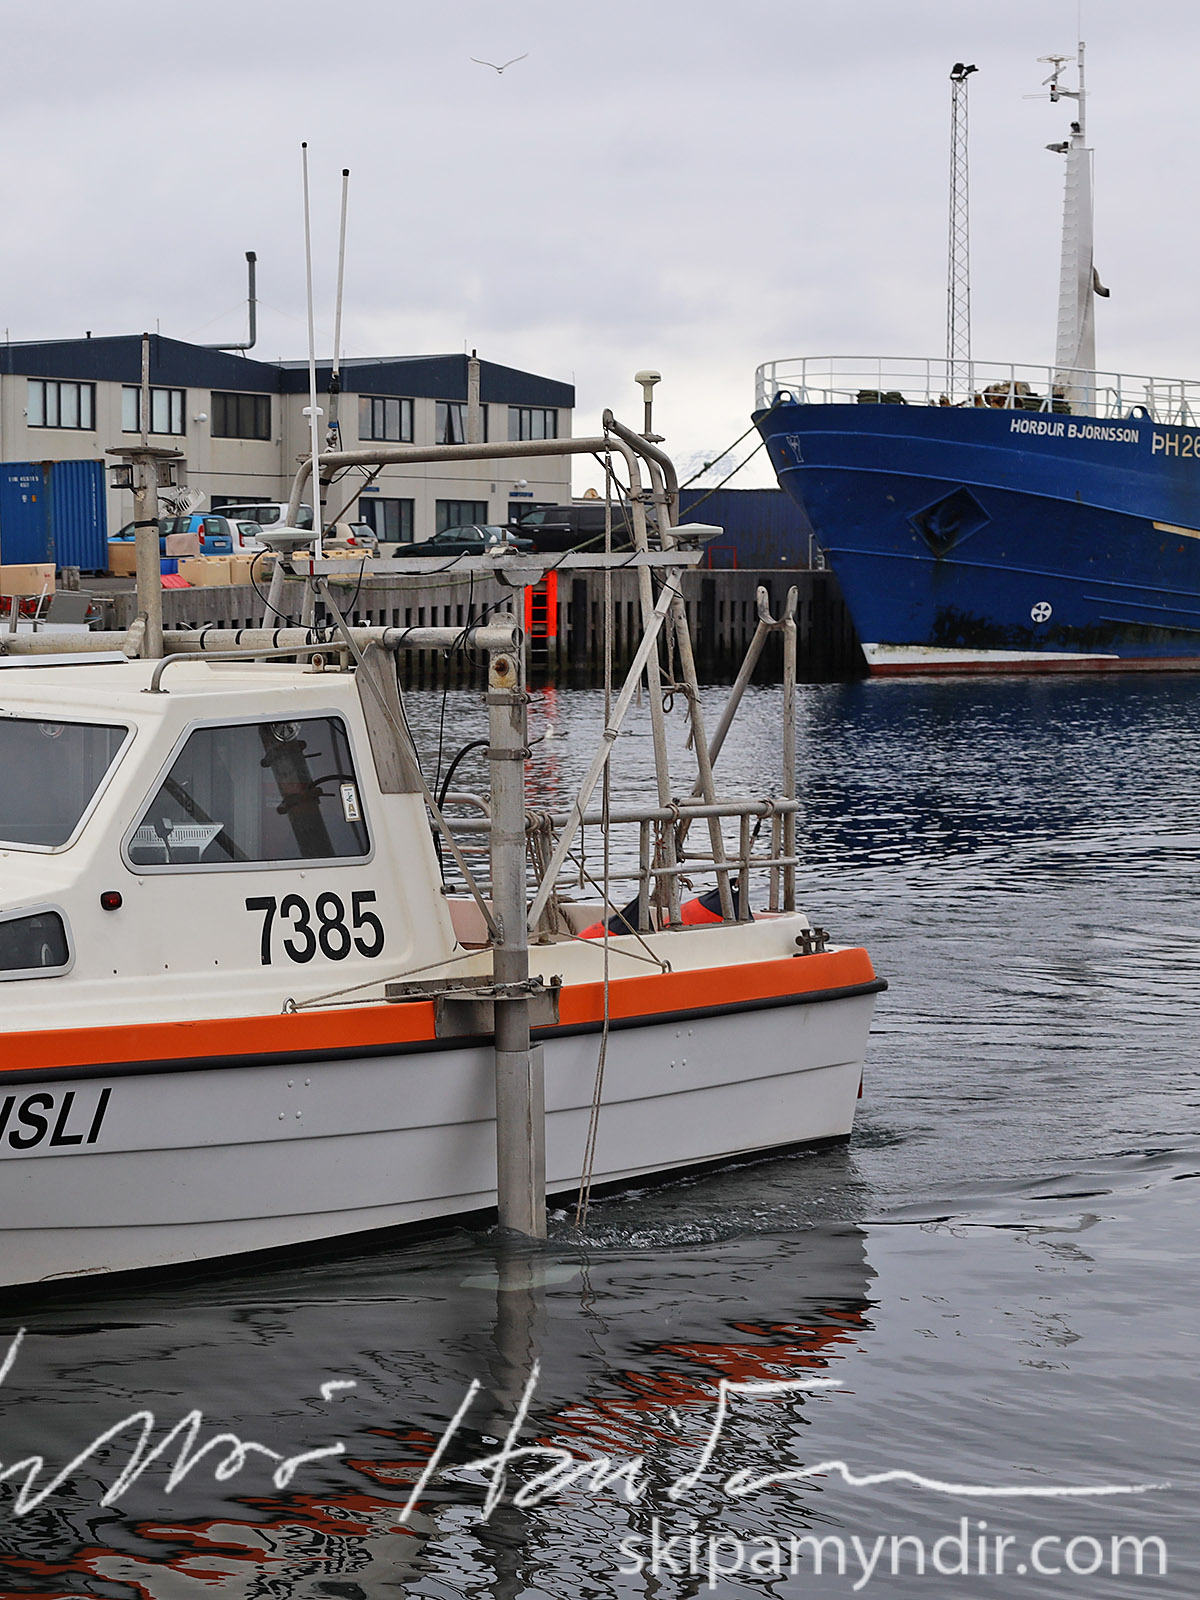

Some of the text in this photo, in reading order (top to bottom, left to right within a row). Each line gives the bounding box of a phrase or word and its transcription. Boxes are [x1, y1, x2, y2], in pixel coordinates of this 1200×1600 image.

[1010, 418, 1140, 443] HÖRÐUR BJÖRNSSON
[245, 890, 385, 965] 7385
